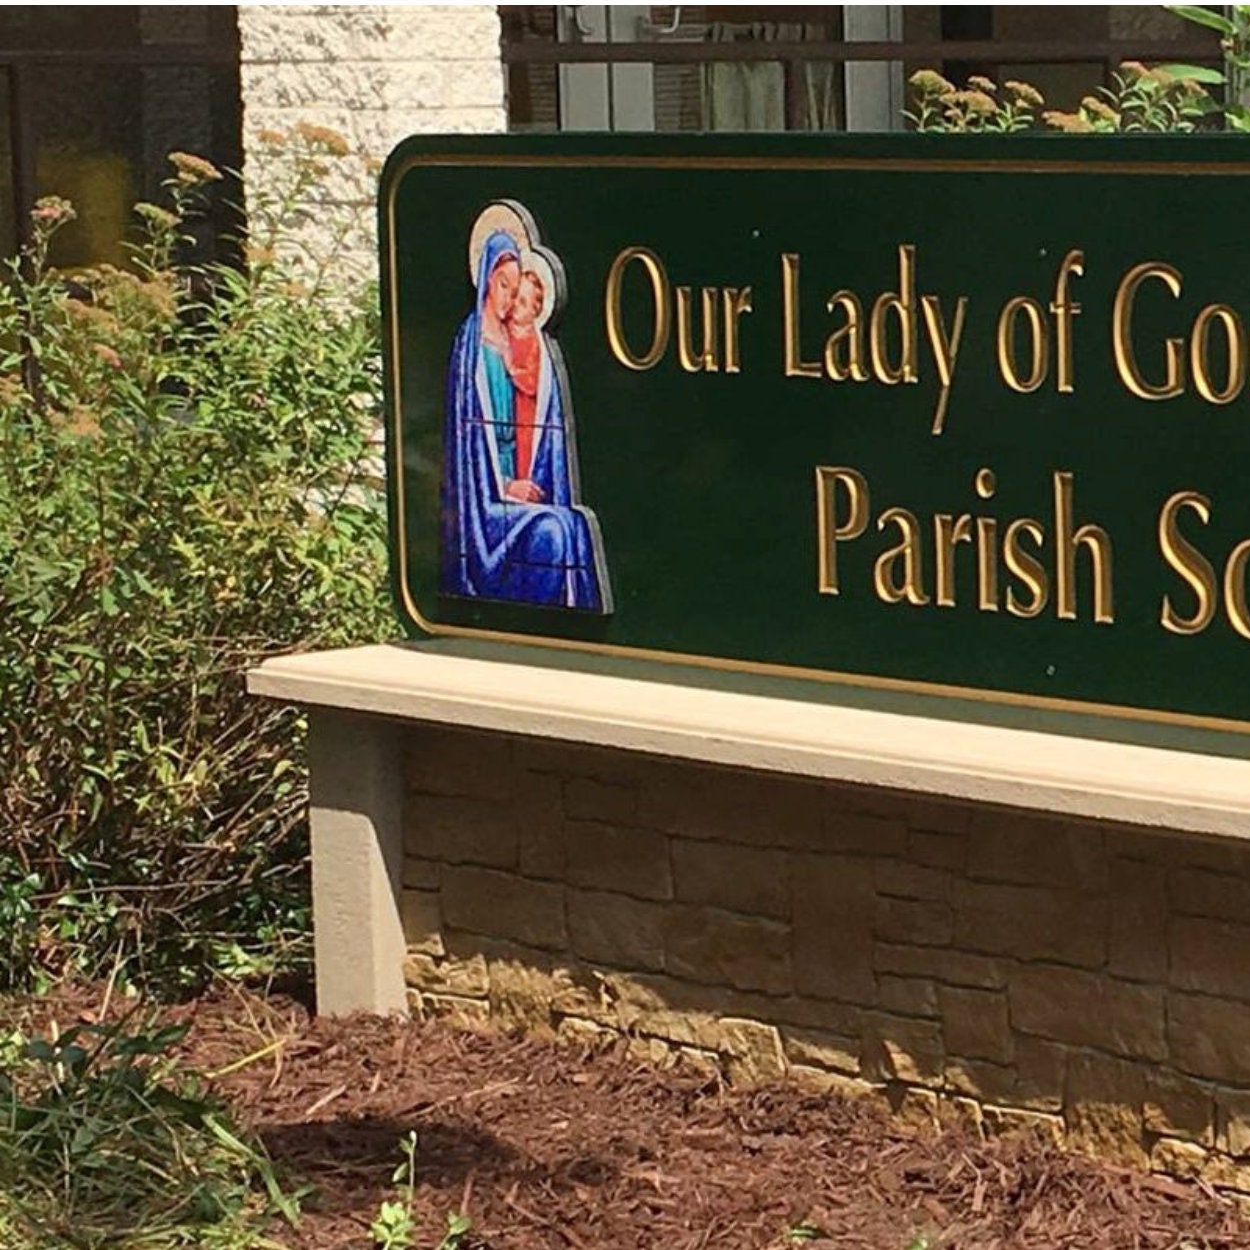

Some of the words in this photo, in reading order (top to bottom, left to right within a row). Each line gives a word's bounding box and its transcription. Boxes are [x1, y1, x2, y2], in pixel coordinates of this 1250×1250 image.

[605, 246, 751, 374] Our
[782, 244, 967, 436] Lady
[997, 249, 1085, 394] of
[815, 466, 1114, 625] Parish
